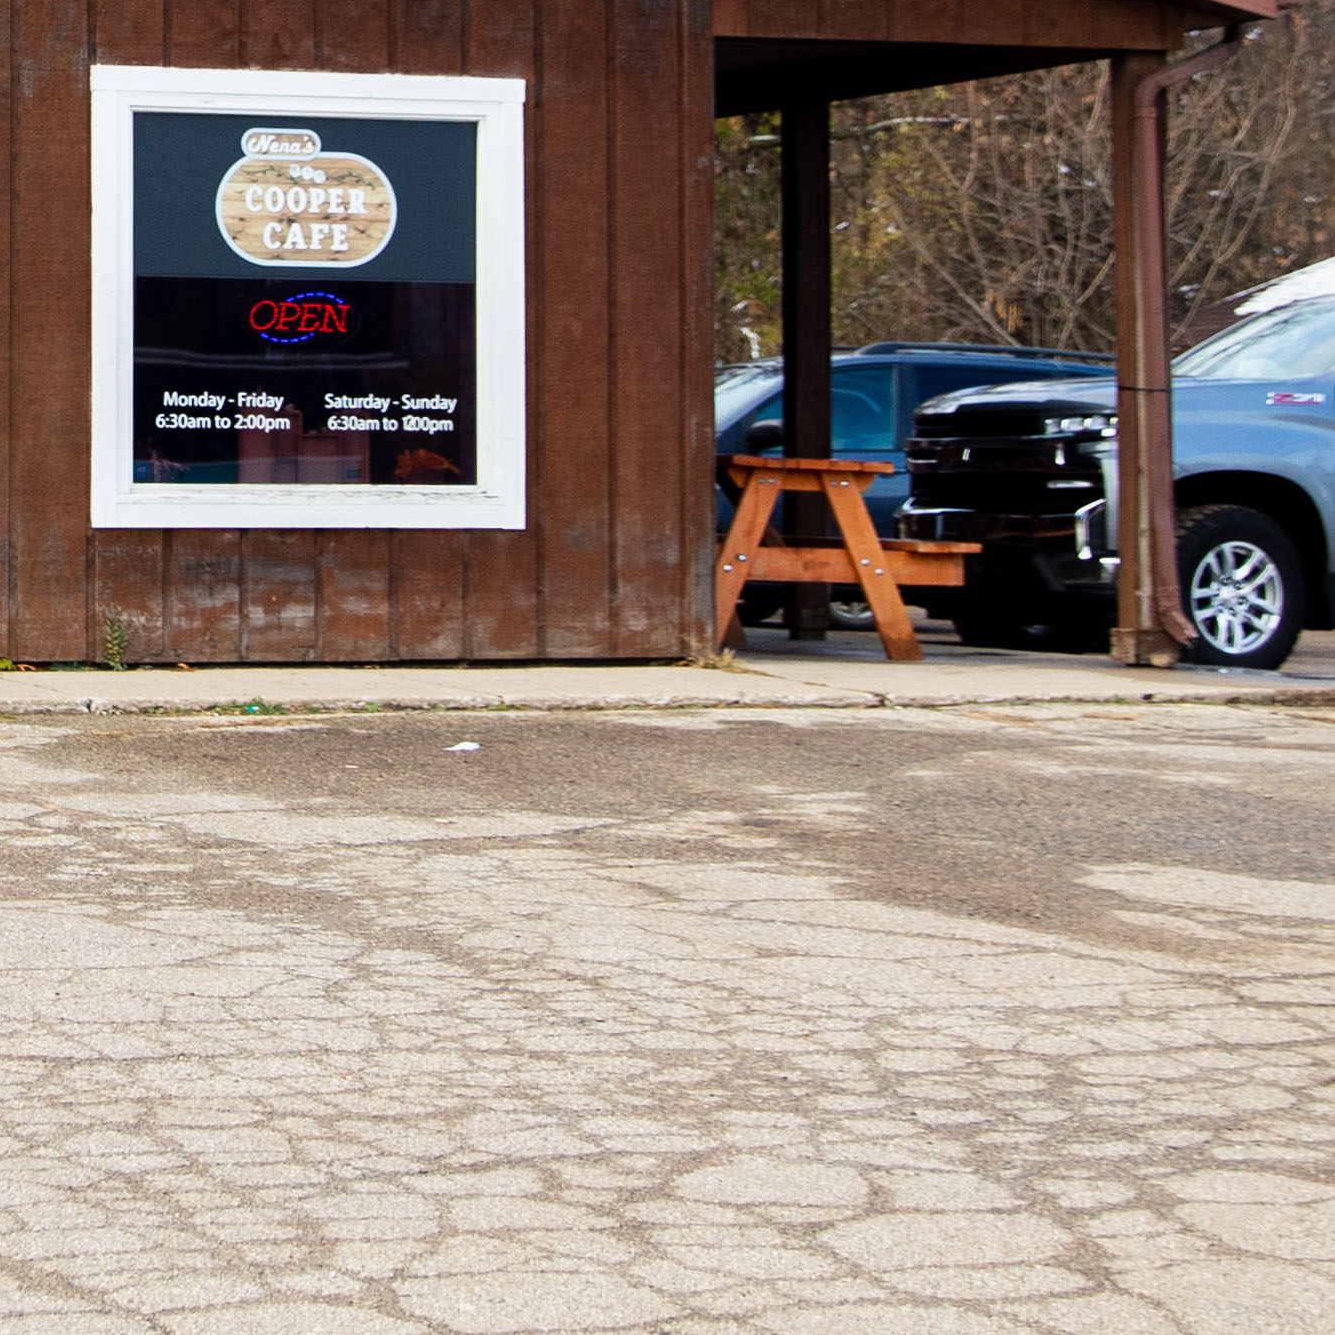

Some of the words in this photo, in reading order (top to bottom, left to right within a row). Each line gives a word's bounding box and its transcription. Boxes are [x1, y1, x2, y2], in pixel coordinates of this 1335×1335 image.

[247, 134, 315, 153] Nena's
[244, 185, 368, 214] COOPER
[262, 222, 349, 251] CAFE
[250, 300, 350, 332] OPEN
[163, 391, 226, 411] Monday
[237, 392, 284, 411] Friday
[324, 393, 390, 413] Saturday
[401, 394, 458, 413] Sunday
[155, 413, 211, 429] 6:30am
[214, 415, 231, 429] to
[233, 414, 291, 433] 2:00pm
[327, 415, 380, 431] 6:30am
[382, 417, 398, 431] to
